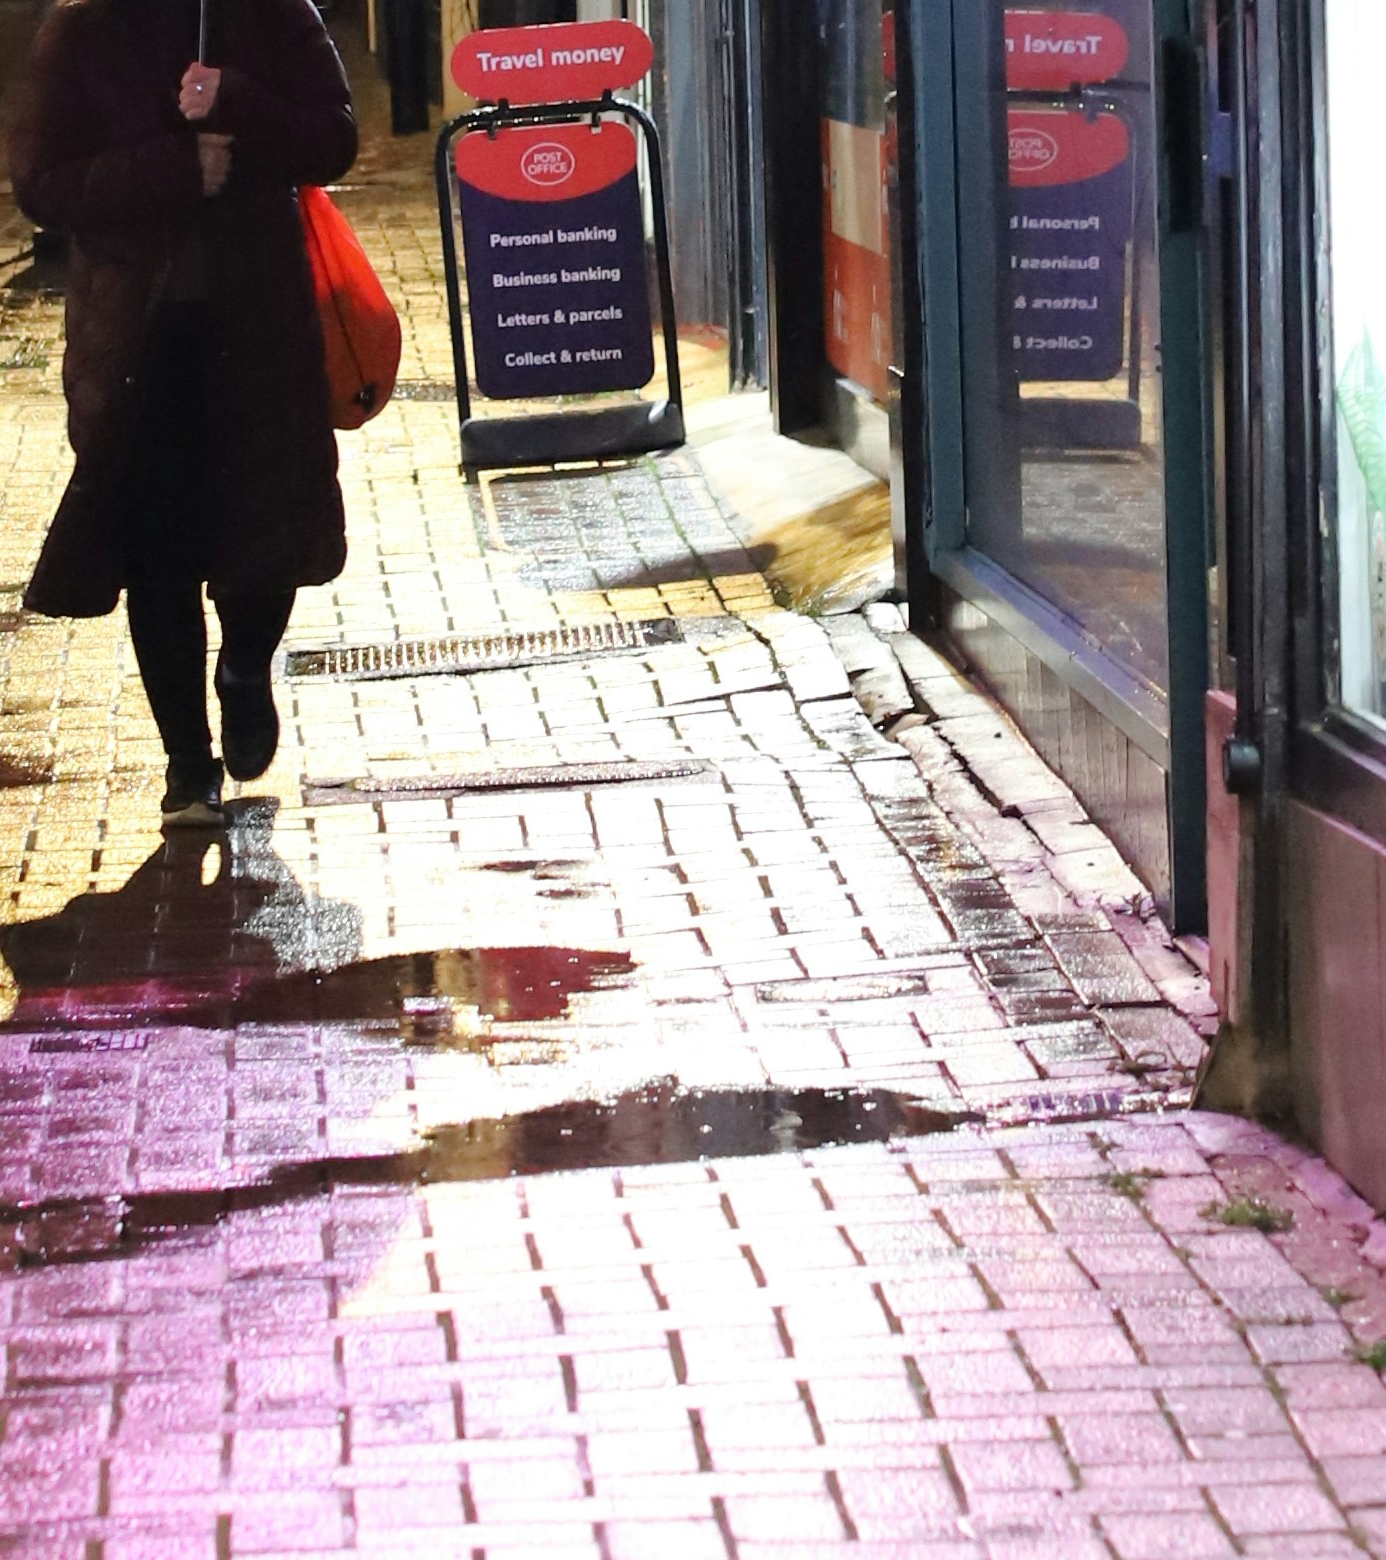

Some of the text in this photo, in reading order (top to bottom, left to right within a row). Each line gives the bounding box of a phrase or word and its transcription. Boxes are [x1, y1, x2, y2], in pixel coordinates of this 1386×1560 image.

[476, 45, 626, 73] Travel money
[526, 161, 568, 176] OFFICE
[533, 151, 563, 164] POST
[489, 225, 618, 248] Personal banking
[492, 265, 622, 288] Business banking
[497, 304, 624, 328] Letters & parcels
[504, 347, 623, 368] Collect & return
